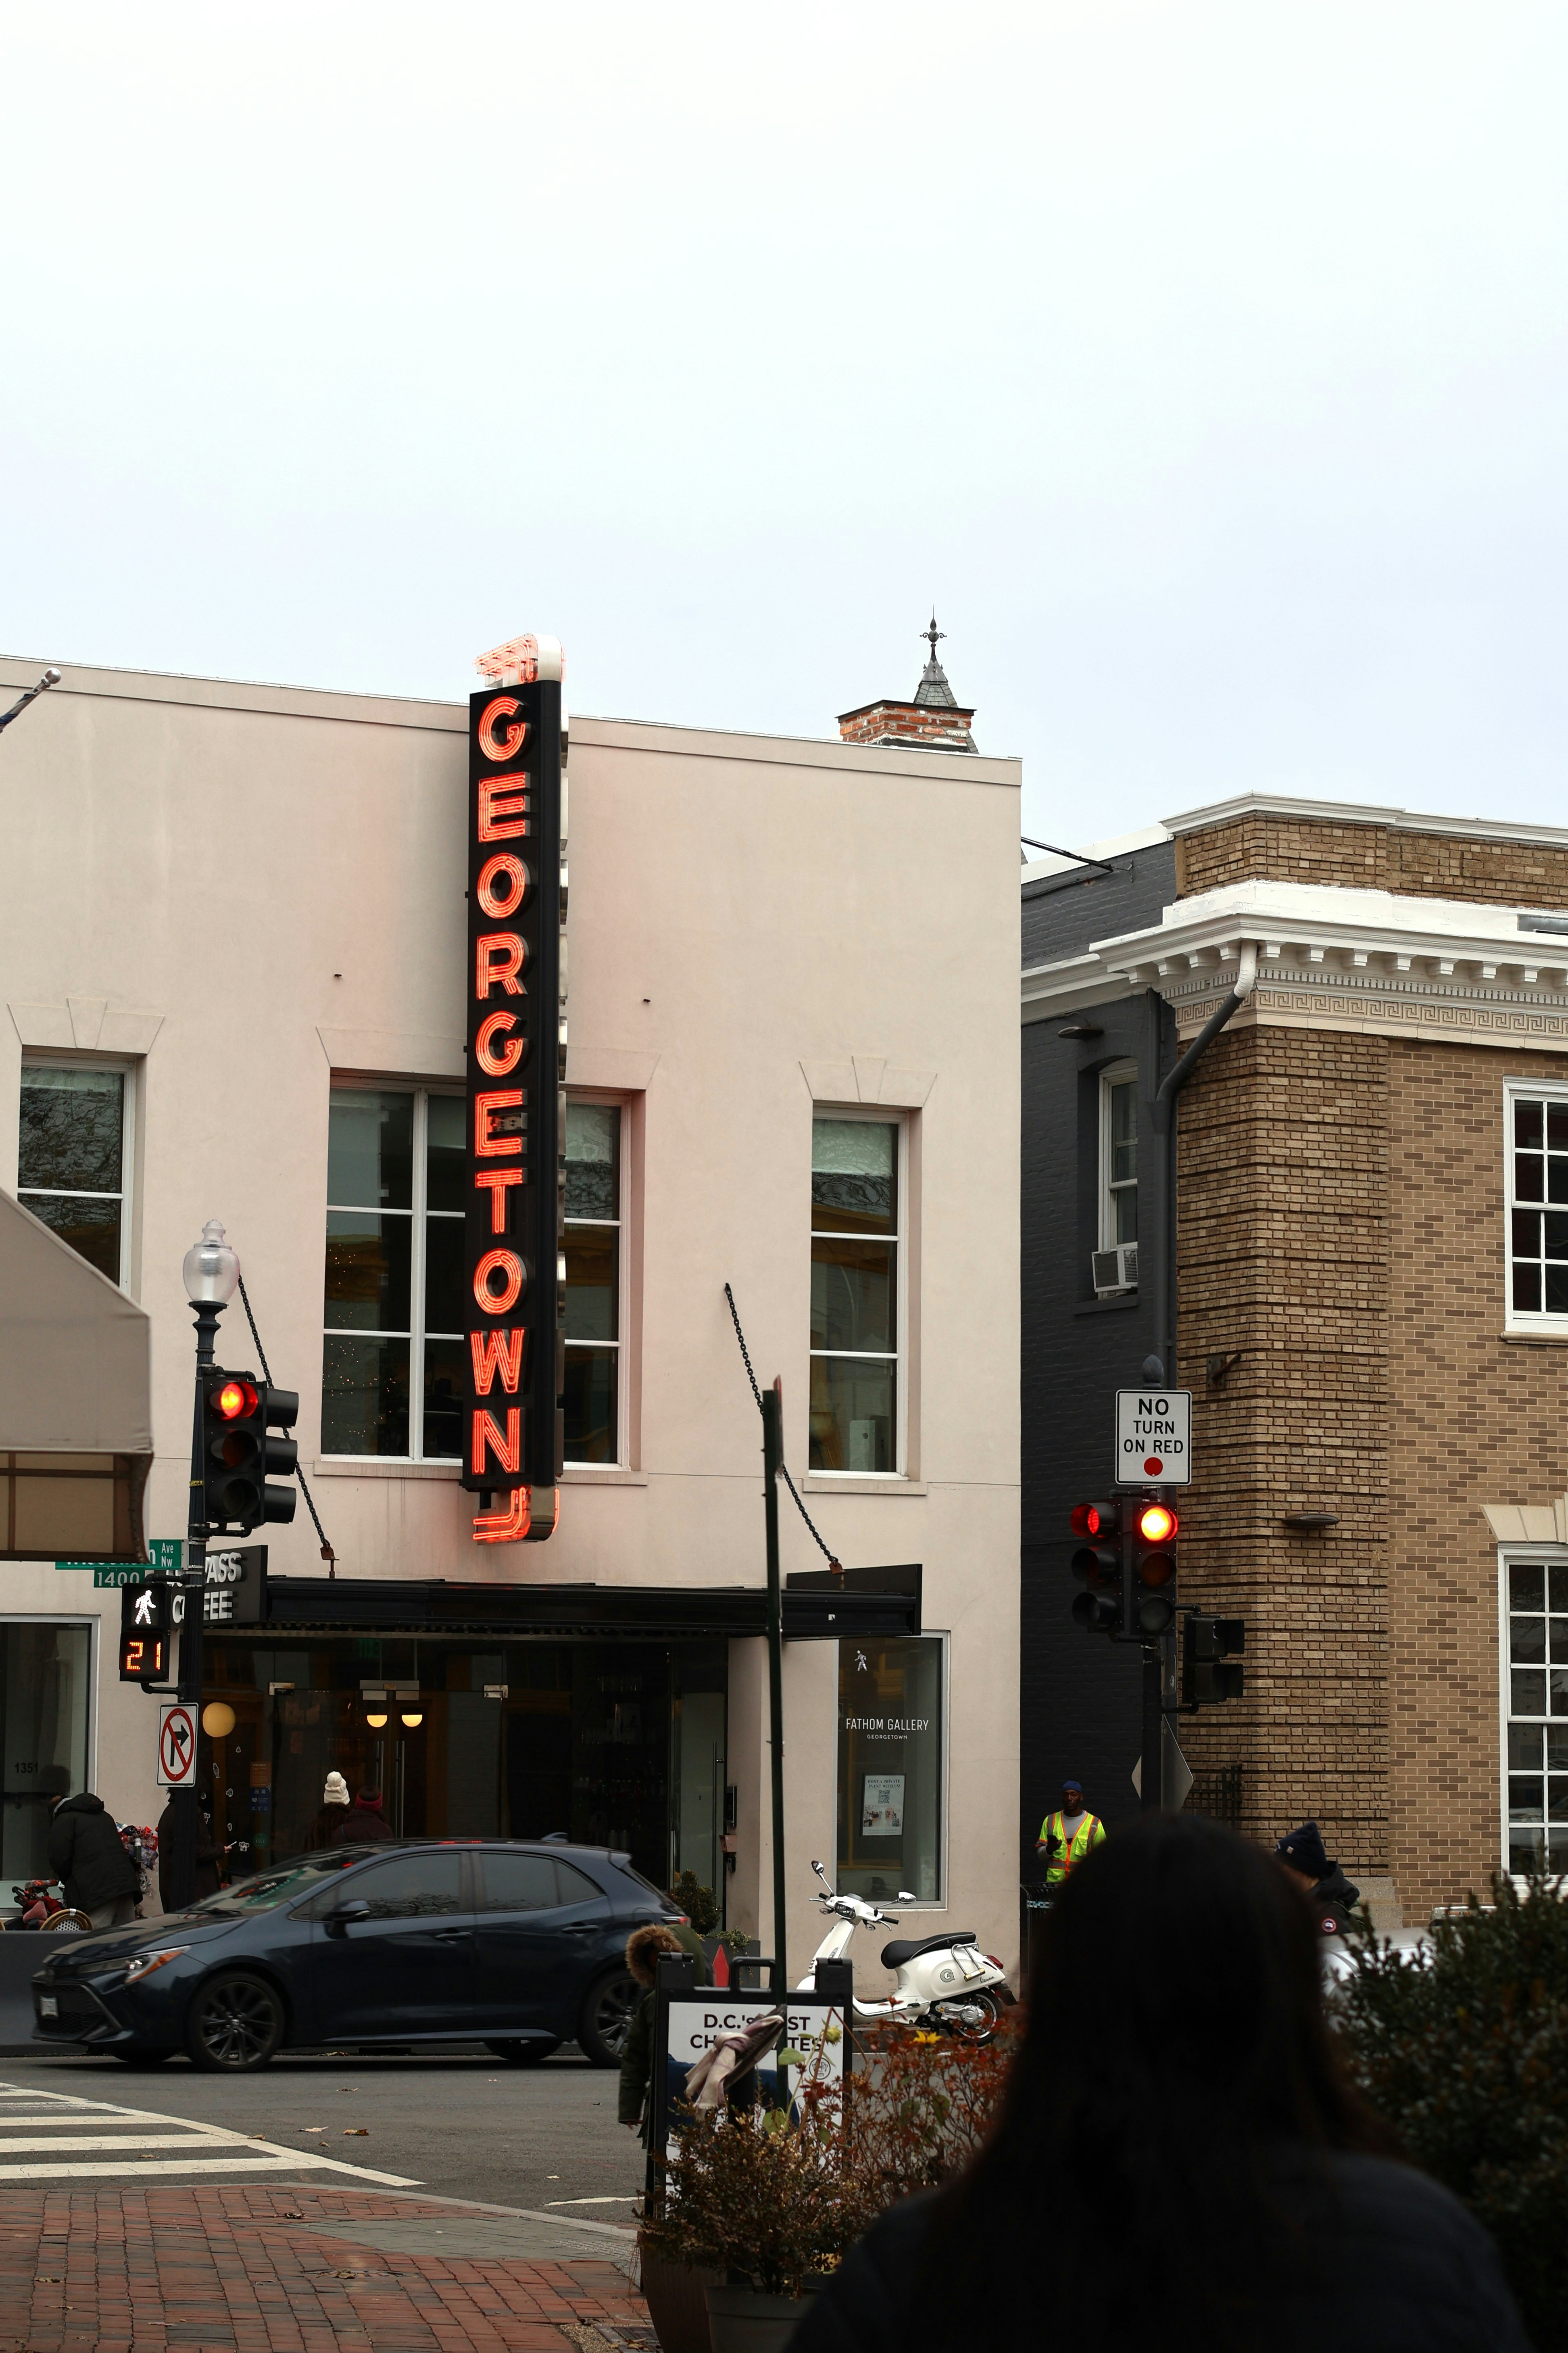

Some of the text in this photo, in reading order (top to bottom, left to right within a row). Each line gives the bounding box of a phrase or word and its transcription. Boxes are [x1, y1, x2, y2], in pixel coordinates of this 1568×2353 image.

[470, 695, 531, 1475] GEORGETOWN
[1139, 1399, 1169, 1416] NO
[1133, 1420, 1174, 1434] TURN
[1124, 1439, 1183, 1453] ON RED
[161, 1543, 174, 1553] Ave
[161, 1556, 173, 1567] Nw
[98, 1572, 140, 1587] 1400
[126, 1642, 161, 1671] 21
[846, 1718, 929, 1731] FATHOM GALLERY
[15, 1762, 38, 1773] 1351
[940, 1969, 955, 1983] G
